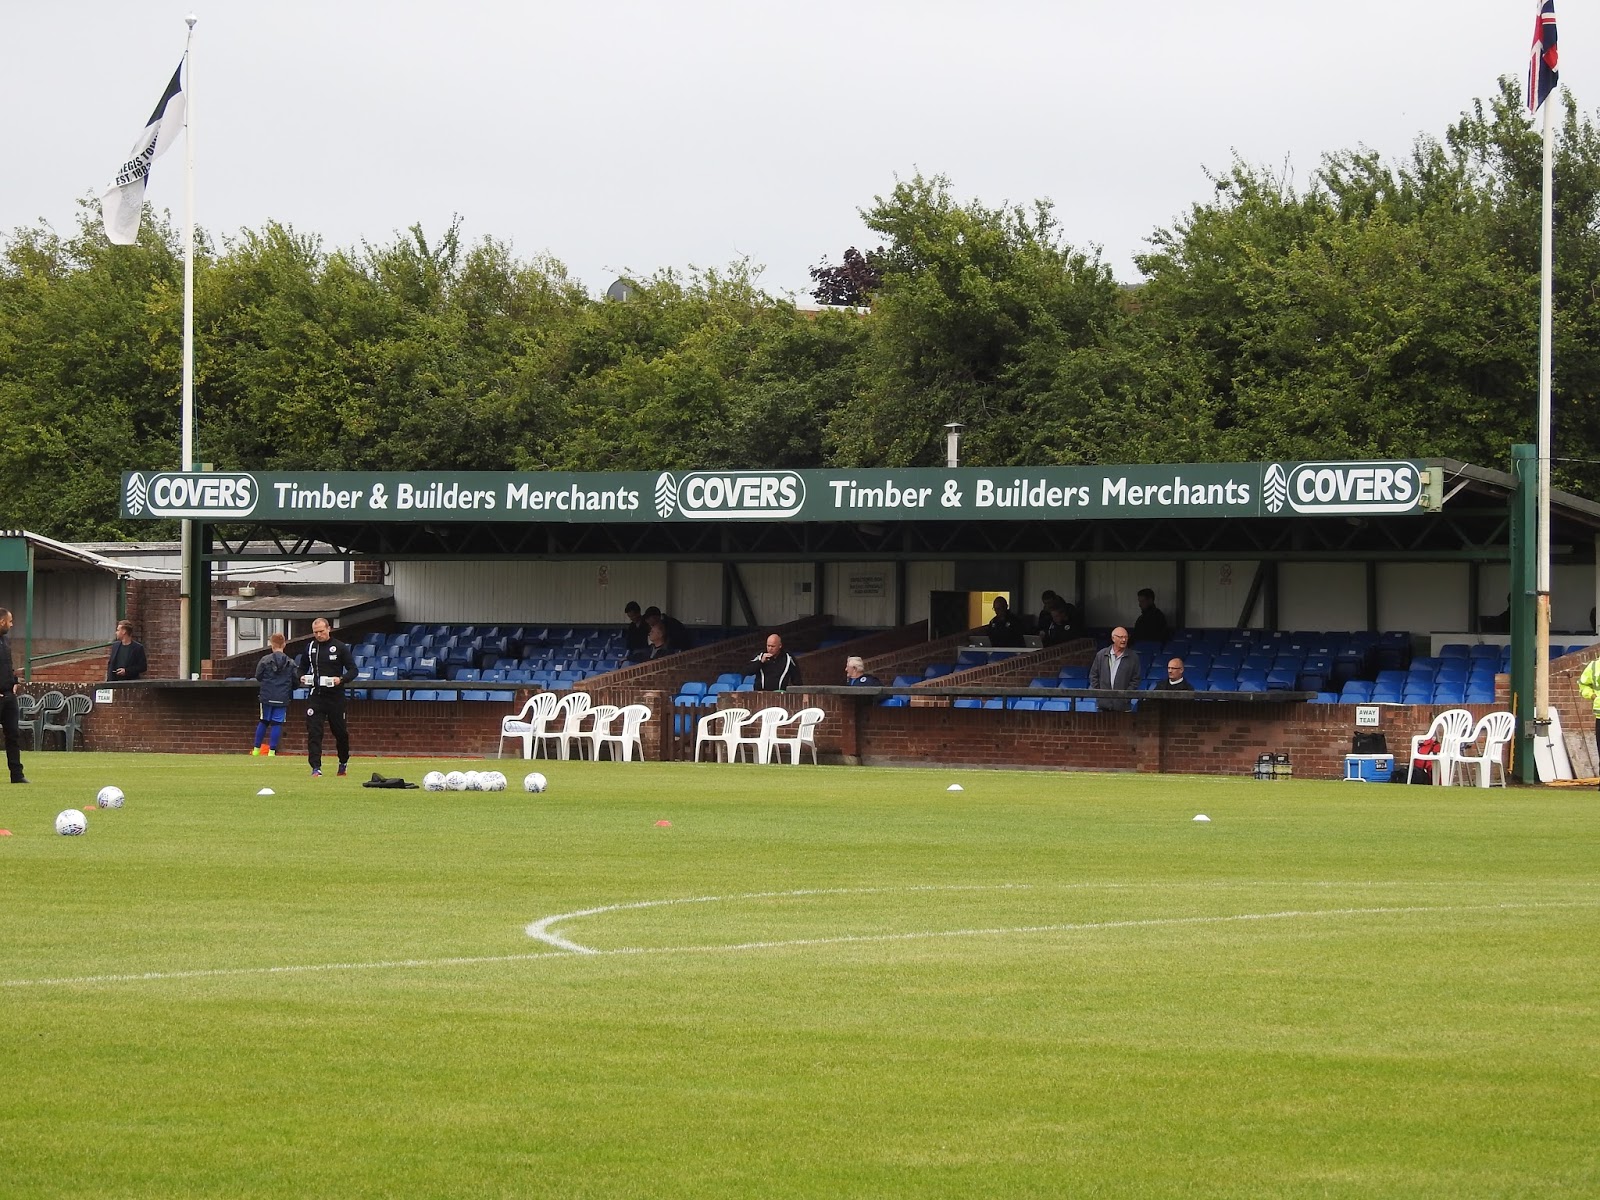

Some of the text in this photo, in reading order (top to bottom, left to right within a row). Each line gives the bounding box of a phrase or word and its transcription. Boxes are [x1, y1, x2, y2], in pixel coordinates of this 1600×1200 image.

[115, 173, 133, 186] EST.
[153, 475, 252, 509] COVERS
[273, 481, 640, 512] Timber & Builders Merchants
[685, 474, 798, 509] COVERS
[828, 475, 1250, 509] Timber & Builders Merchants
[1296, 466, 1413, 503] COVERS
